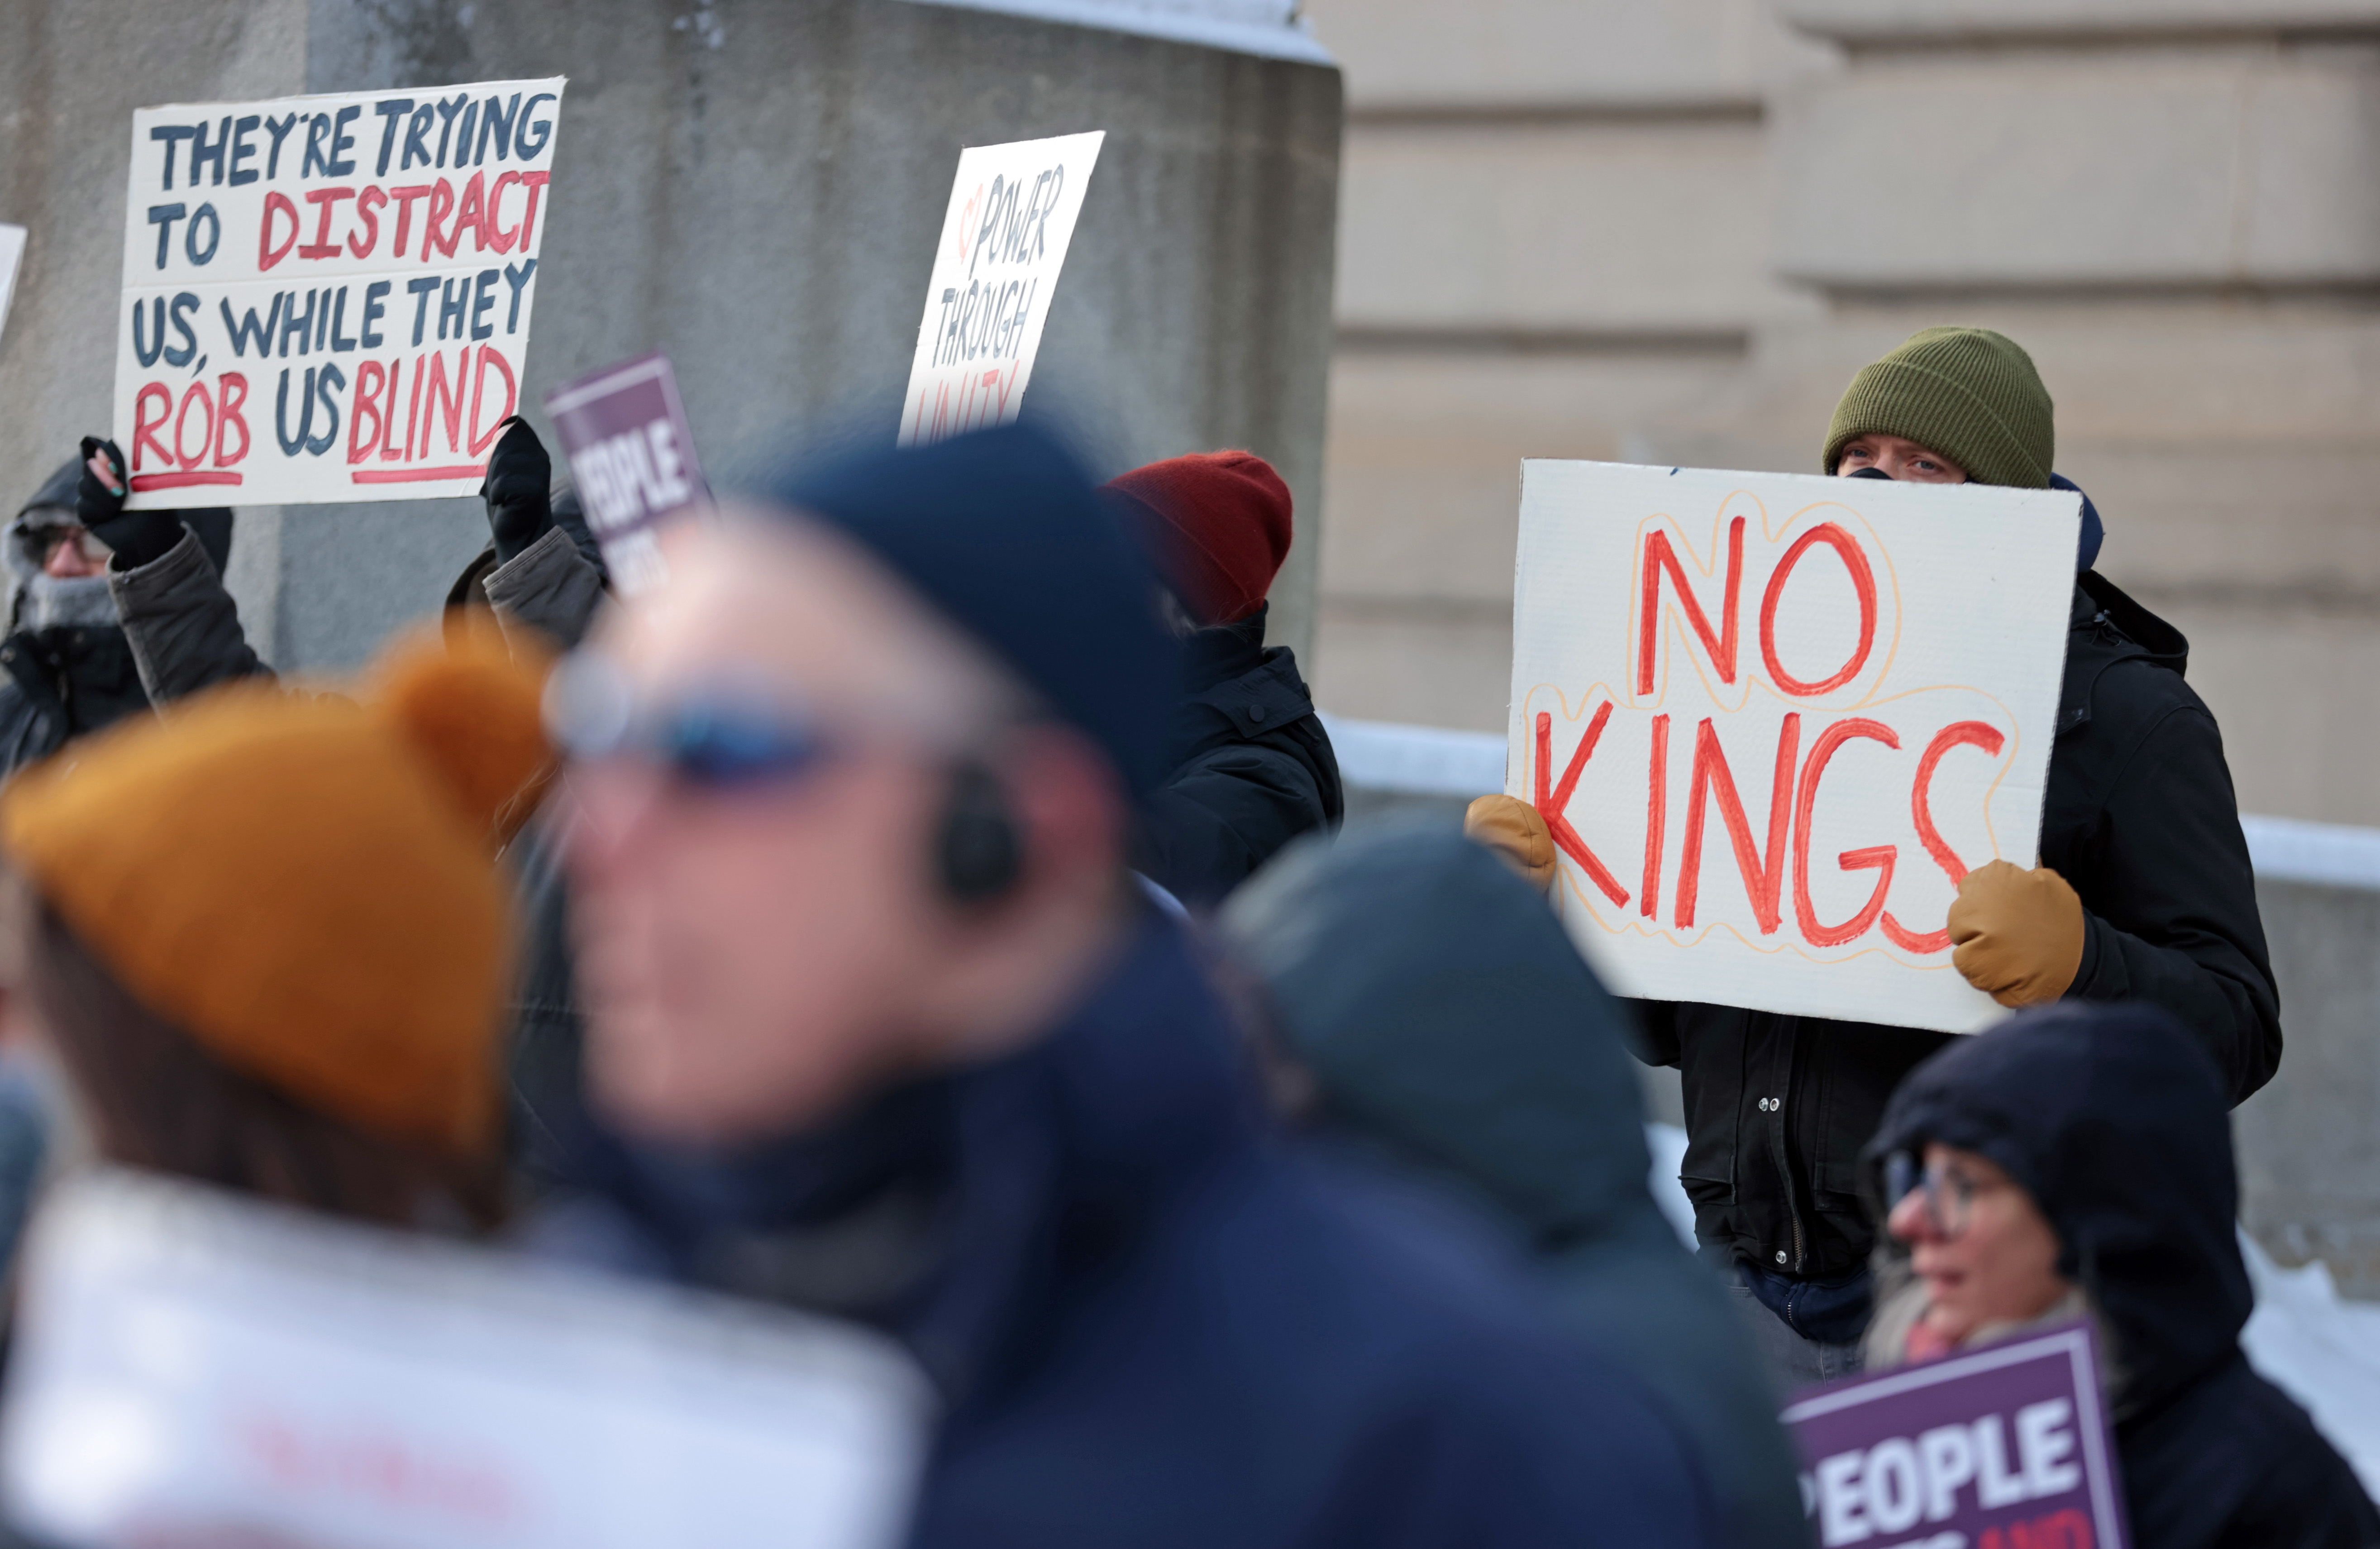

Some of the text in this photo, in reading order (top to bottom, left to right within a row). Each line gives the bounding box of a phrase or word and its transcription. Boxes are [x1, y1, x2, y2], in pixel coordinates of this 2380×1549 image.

[150, 92, 557, 191] THEY'RE TRYING
[148, 169, 551, 272] TO DISTRACT
[968, 163, 1064, 281] POWER
[133, 258, 537, 378] US, WHILE THEY
[932, 277, 1038, 368] THROUGH
[131, 343, 517, 472] ROB US BLIND
[1637, 515, 1877, 697] NO
[1533, 700, 2005, 954] KINGS
